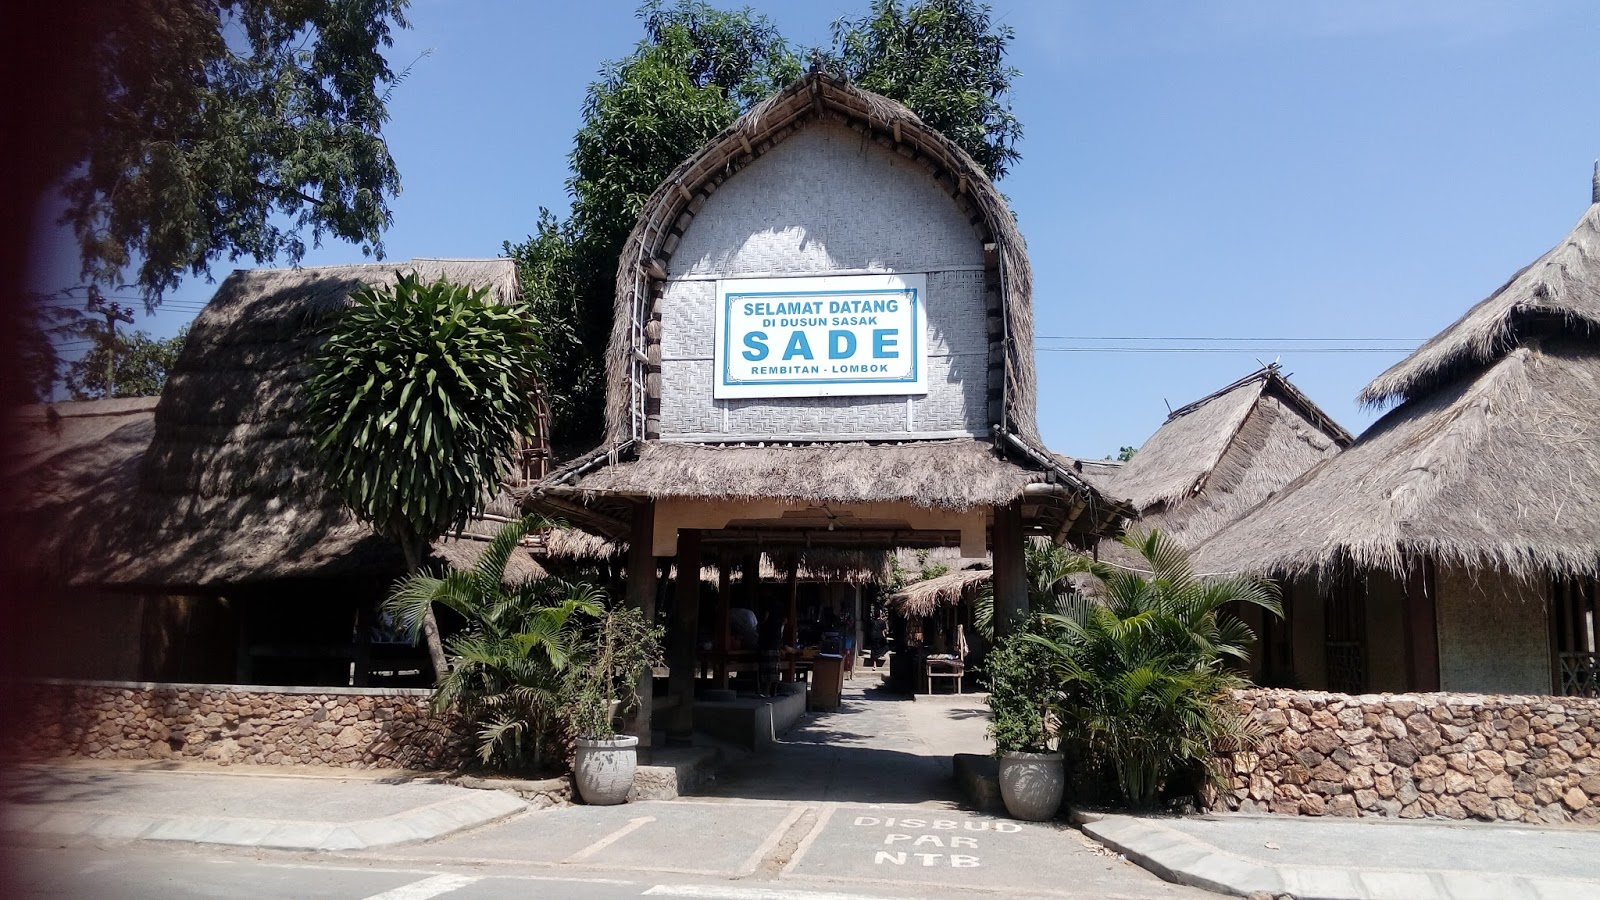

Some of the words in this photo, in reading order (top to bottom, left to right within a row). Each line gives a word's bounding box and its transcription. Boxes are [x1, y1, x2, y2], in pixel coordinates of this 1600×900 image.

[743, 302, 823, 316] SELAMAT
[829, 300, 898, 314] DATANG
[762, 318, 776, 328] DI
[780, 317, 827, 327] DUSUN
[832, 316, 877, 326] SASAK
[741, 328, 899, 362] SADE
[751, 365, 819, 375] REMBITAN
[832, 364, 888, 374] LOMBOK
[853, 816, 1023, 834] DISBUD
[884, 833, 979, 849] PAR
[874, 851, 981, 868] NTB
